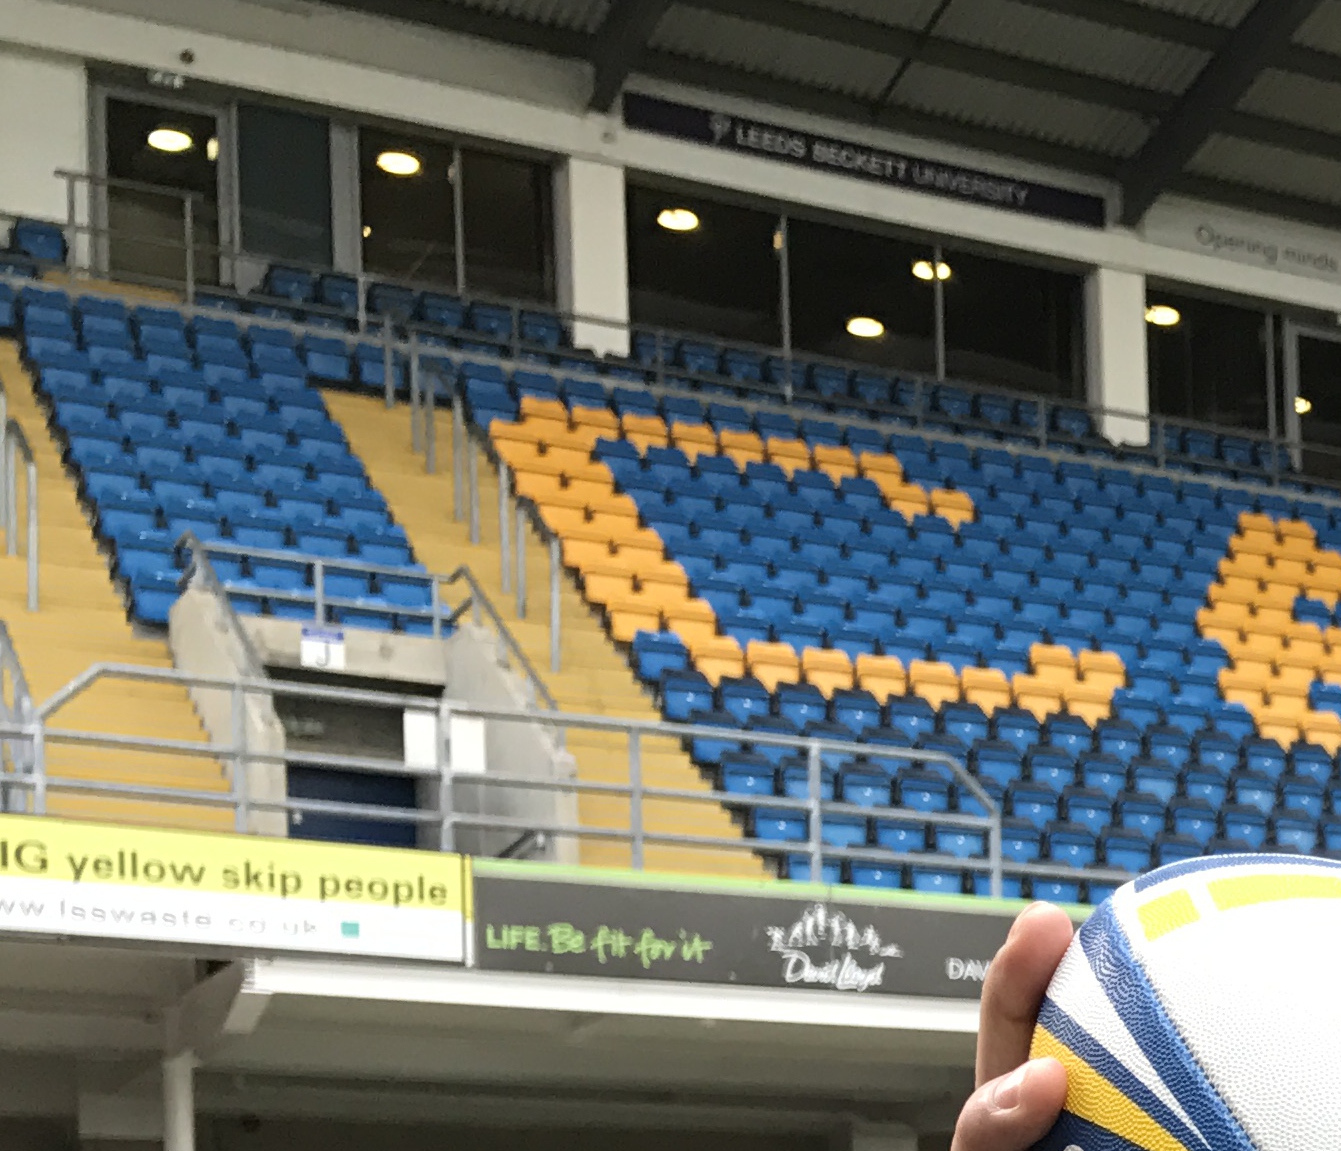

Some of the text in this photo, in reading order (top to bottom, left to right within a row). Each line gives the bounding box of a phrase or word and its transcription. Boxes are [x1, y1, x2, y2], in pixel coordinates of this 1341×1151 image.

[736, 122, 1028, 207] LEEDS BECKETT UNIVERSITY
[67, 849, 206, 885] yellow
[222, 860, 301, 898] skip
[319, 871, 448, 908] people
[547, 922, 585, 954] Be
[590, 924, 633, 964] fit
[634, 927, 676, 969] for
[678, 928, 714, 964] it
